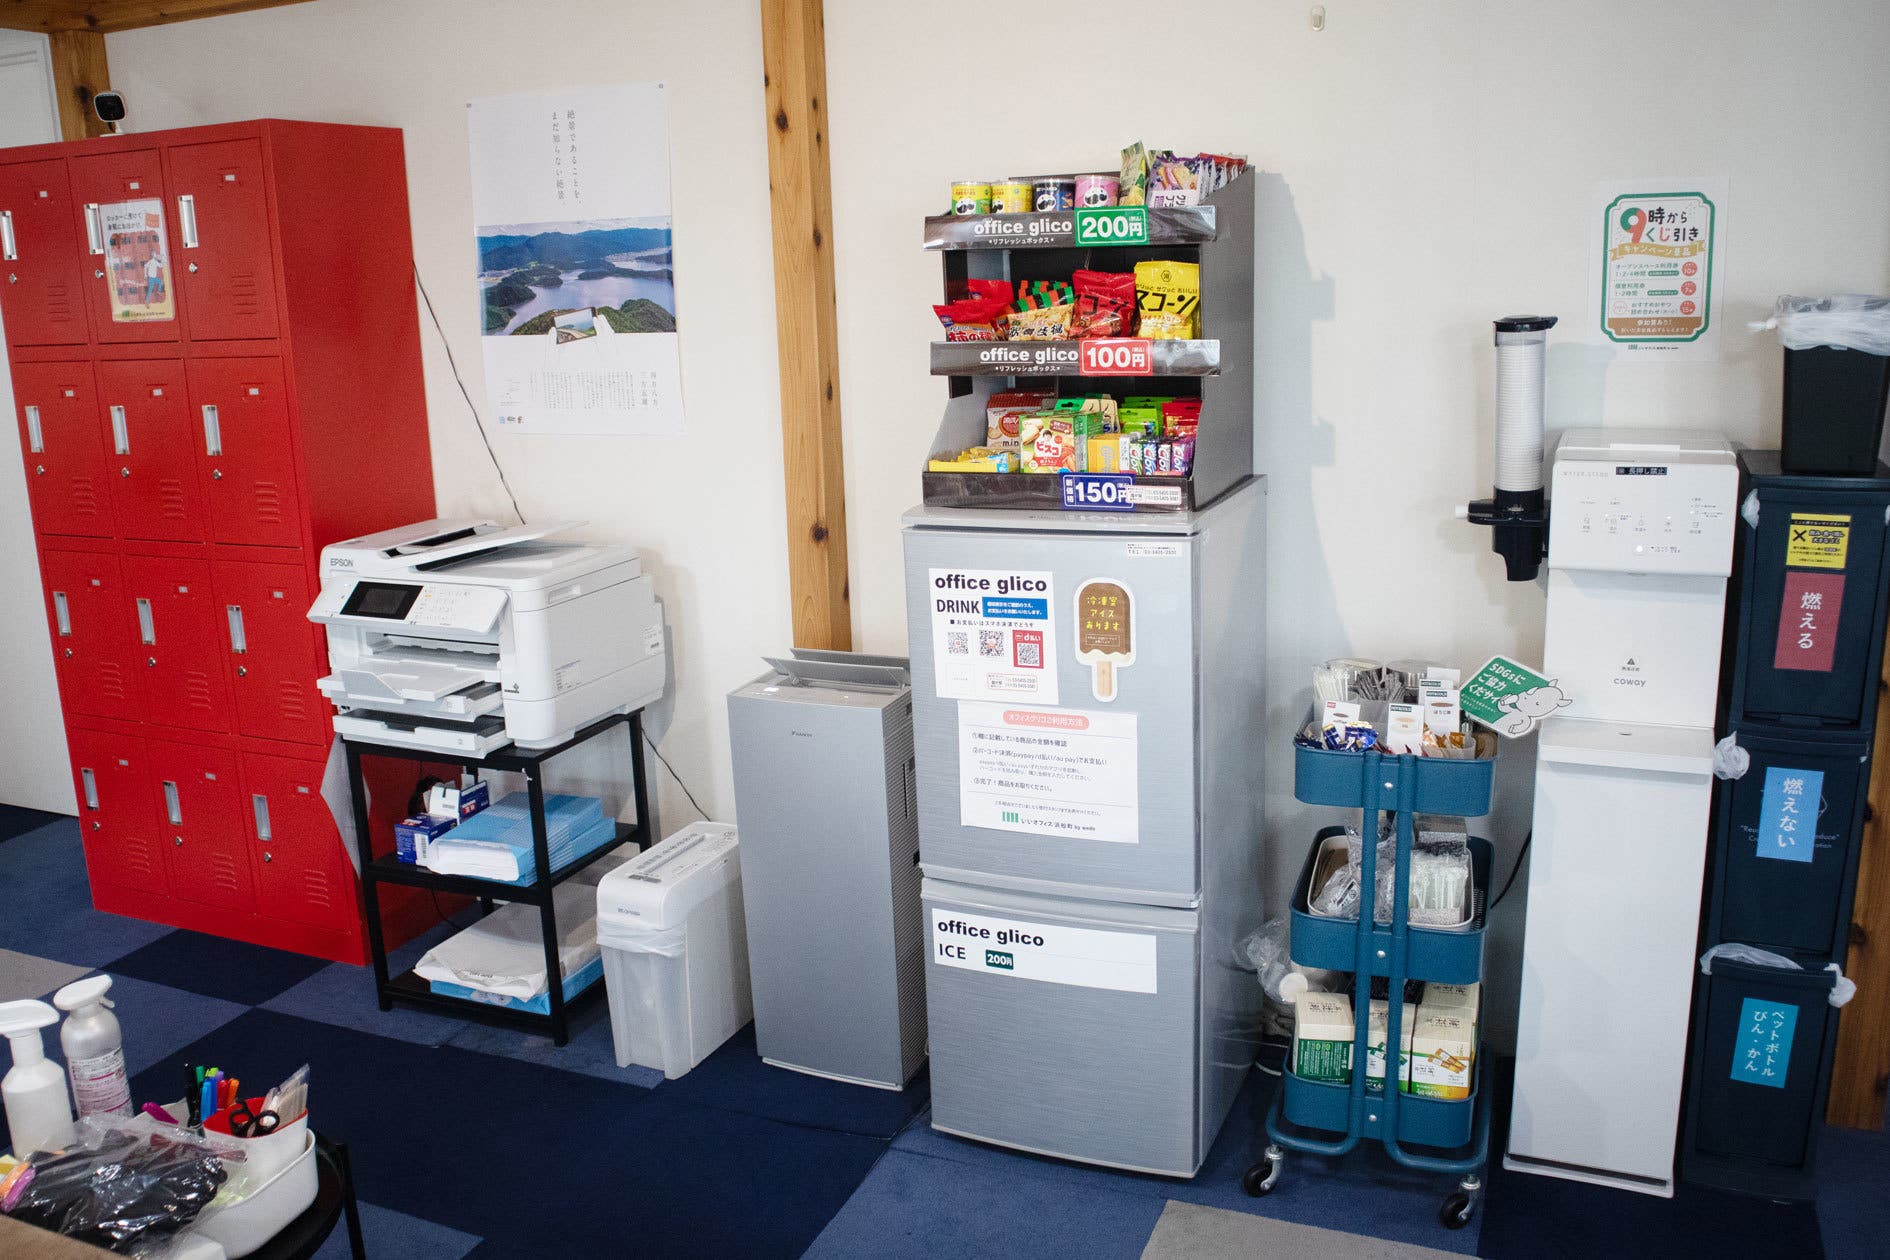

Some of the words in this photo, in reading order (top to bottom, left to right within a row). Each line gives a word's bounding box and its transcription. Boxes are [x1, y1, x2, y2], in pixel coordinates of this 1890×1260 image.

[1648, 206, 1688, 225] 時から
[974, 220, 1024, 235] office
[1029, 220, 1072, 237] glico
[1082, 216, 1142, 238] 200円
[1646, 226, 1700, 242] くじ引き
[980, 348, 1030, 362] office
[1036, 348, 1078, 364] glico
[1086, 346, 1146, 368] 100円
[1036, 441, 1060, 456] ビスコ
[330, 558, 354, 567] EPSON
[934, 574, 990, 590] office
[997, 576, 1047, 594] glico
[936, 599, 980, 614] DRINK
[1090, 608, 1114, 618] アイス
[1086, 620, 1120, 631] あります
[1797, 592, 1823, 650] 燃える
[1478, 673, 1507, 692] ご協力
[1489, 663, 1526, 686] SDGsに
[1613, 678, 1646, 687] coway
[1776, 778, 1804, 849] 燃えない
[937, 920, 991, 939] office
[996, 928, 1044, 947] glico
[938, 943, 967, 960] ICE
[987, 952, 1013, 967] 200円
[1744, 1009, 1768, 1073] びん・かん
[1761, 1009, 1785, 1078] ペットボトル
